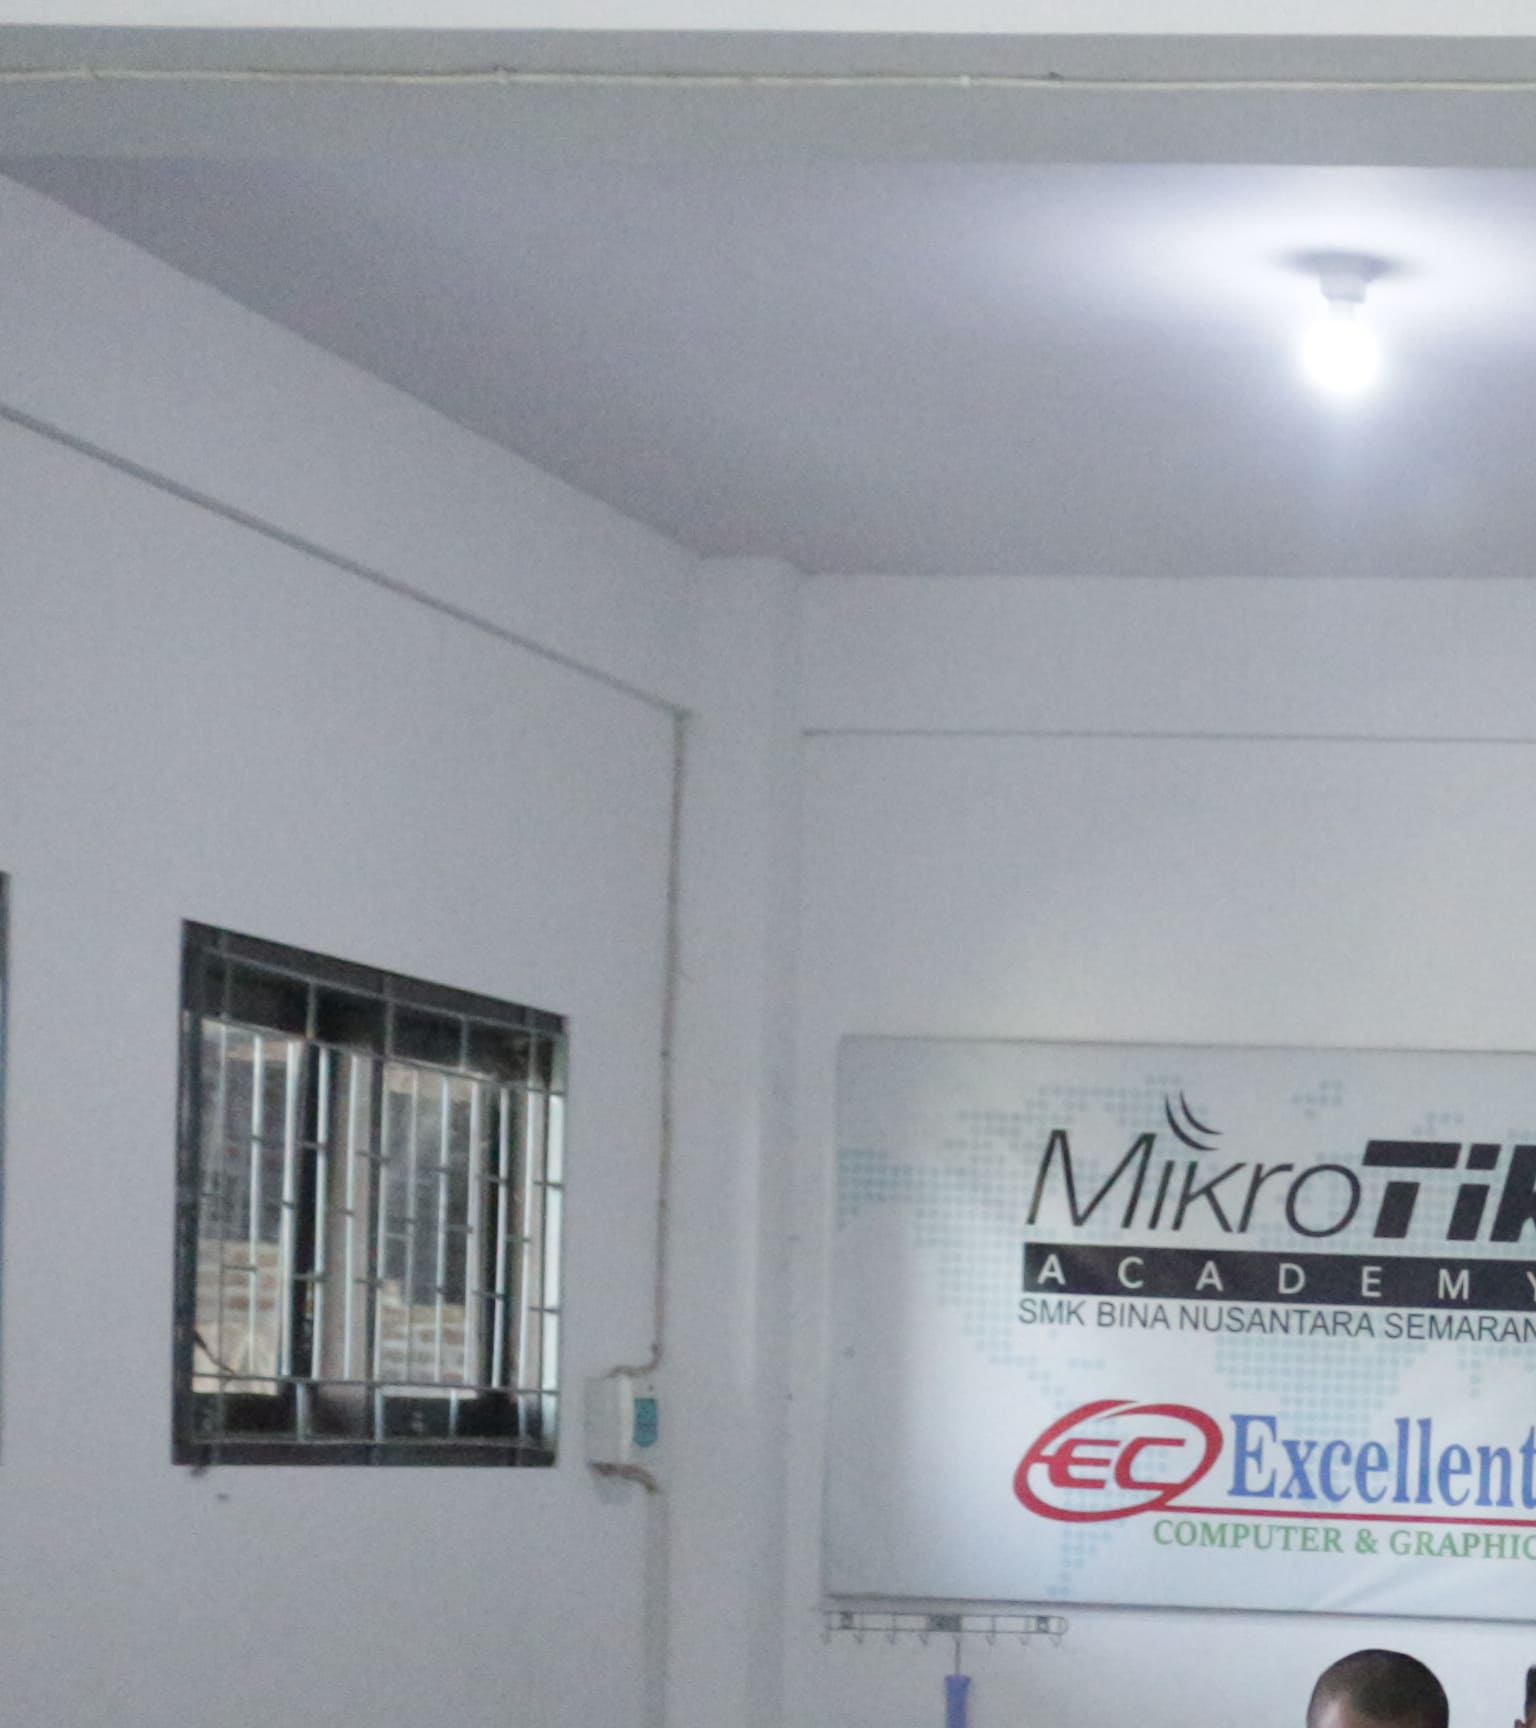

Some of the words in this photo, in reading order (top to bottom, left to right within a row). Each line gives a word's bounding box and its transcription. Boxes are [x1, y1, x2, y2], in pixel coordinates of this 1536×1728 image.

[1018, 1297, 1087, 1327] SMK
[1096, 1300, 1173, 1331] BINA
[1180, 1303, 1376, 1338] NUSANTARA
[1153, 1518, 1344, 1553] COMPUTER
[1355, 1524, 1378, 1555] &
